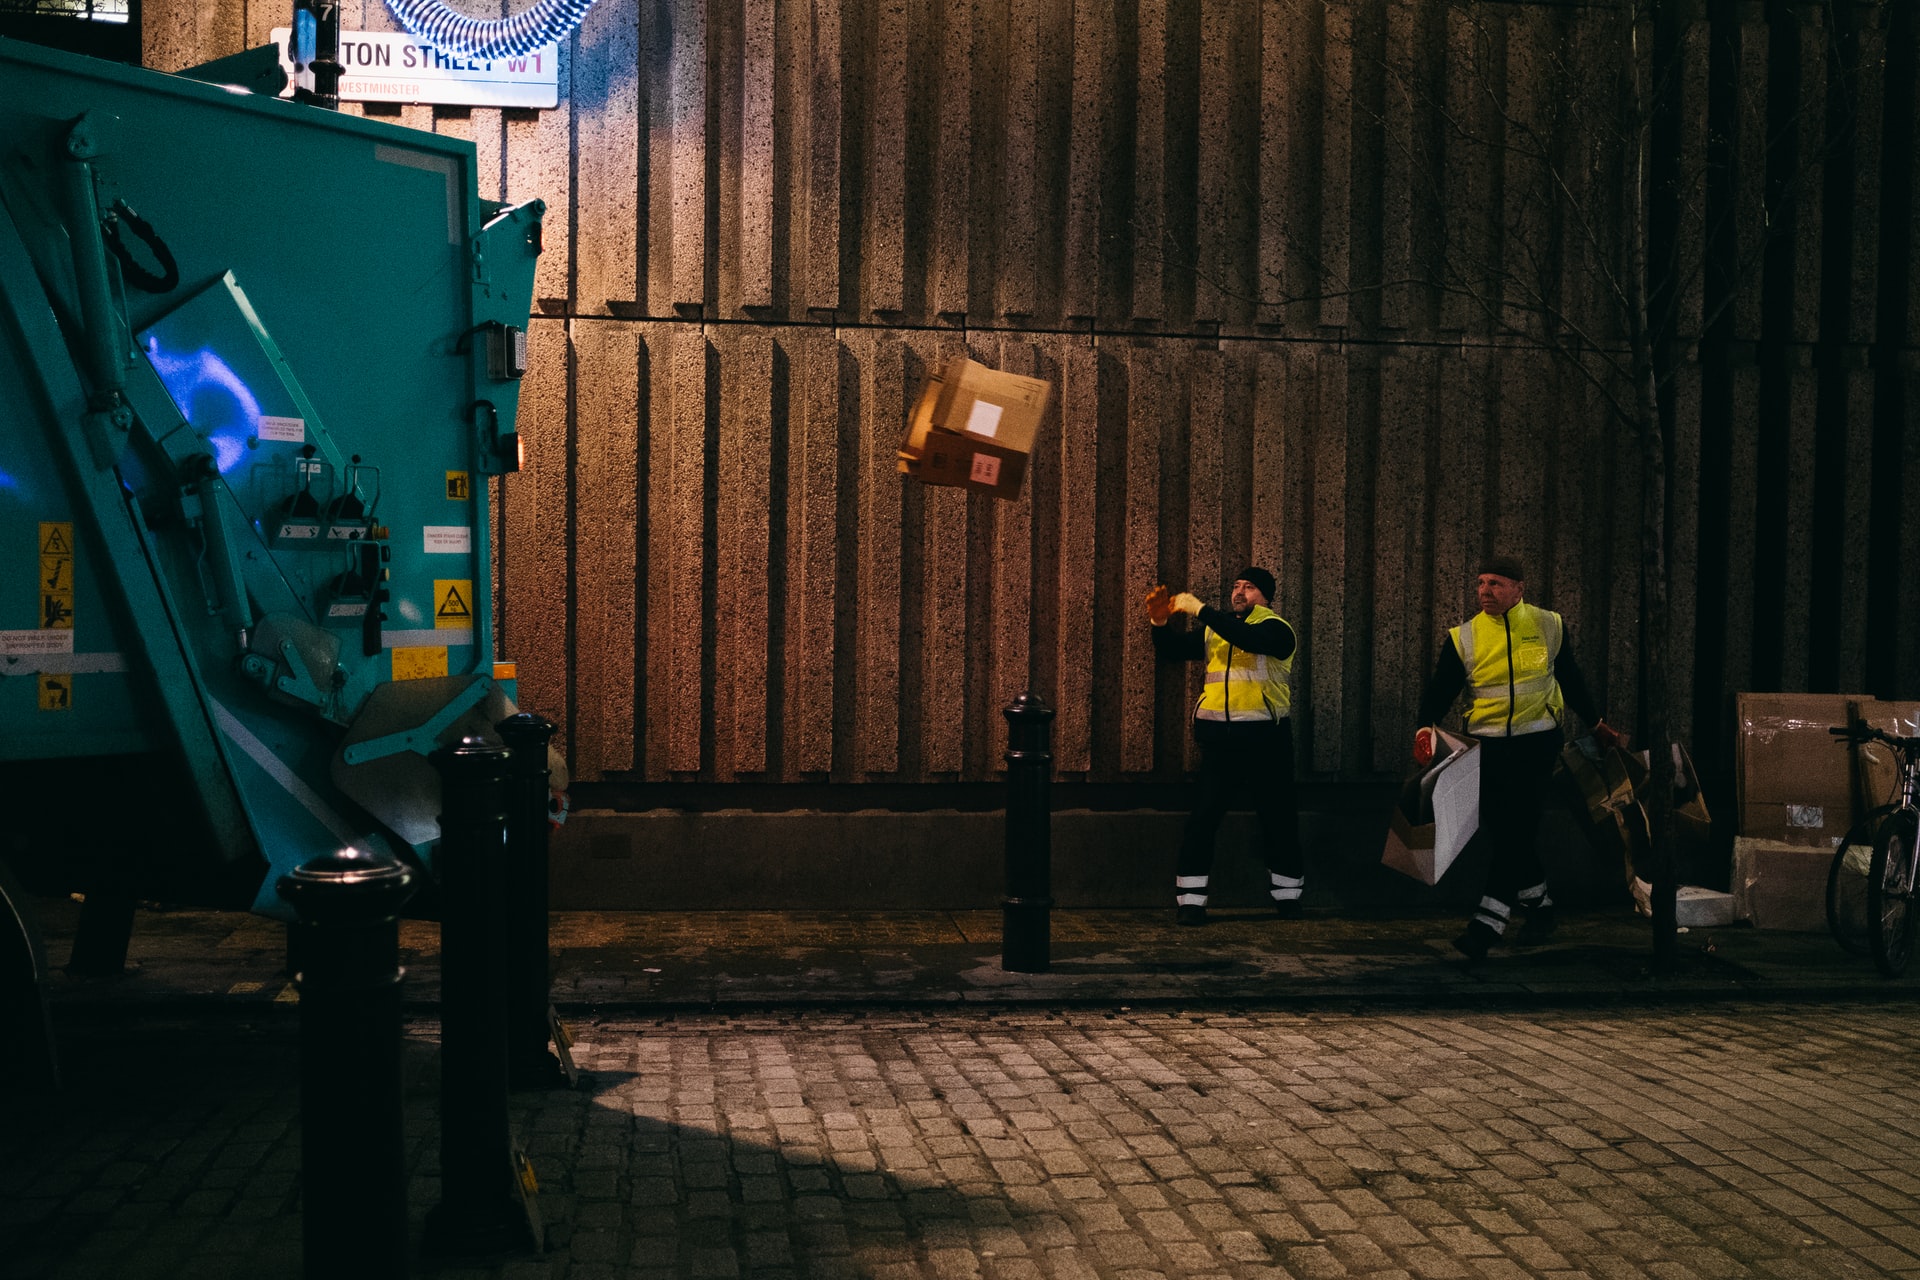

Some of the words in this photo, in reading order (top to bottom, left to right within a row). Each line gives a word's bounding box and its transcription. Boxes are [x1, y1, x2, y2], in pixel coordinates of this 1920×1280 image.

[320, 4, 333, 21] 7
[341, 42, 391, 67] TON
[507, 53, 542, 73] W1
[338, 81, 420, 95] WESTMINSTER
